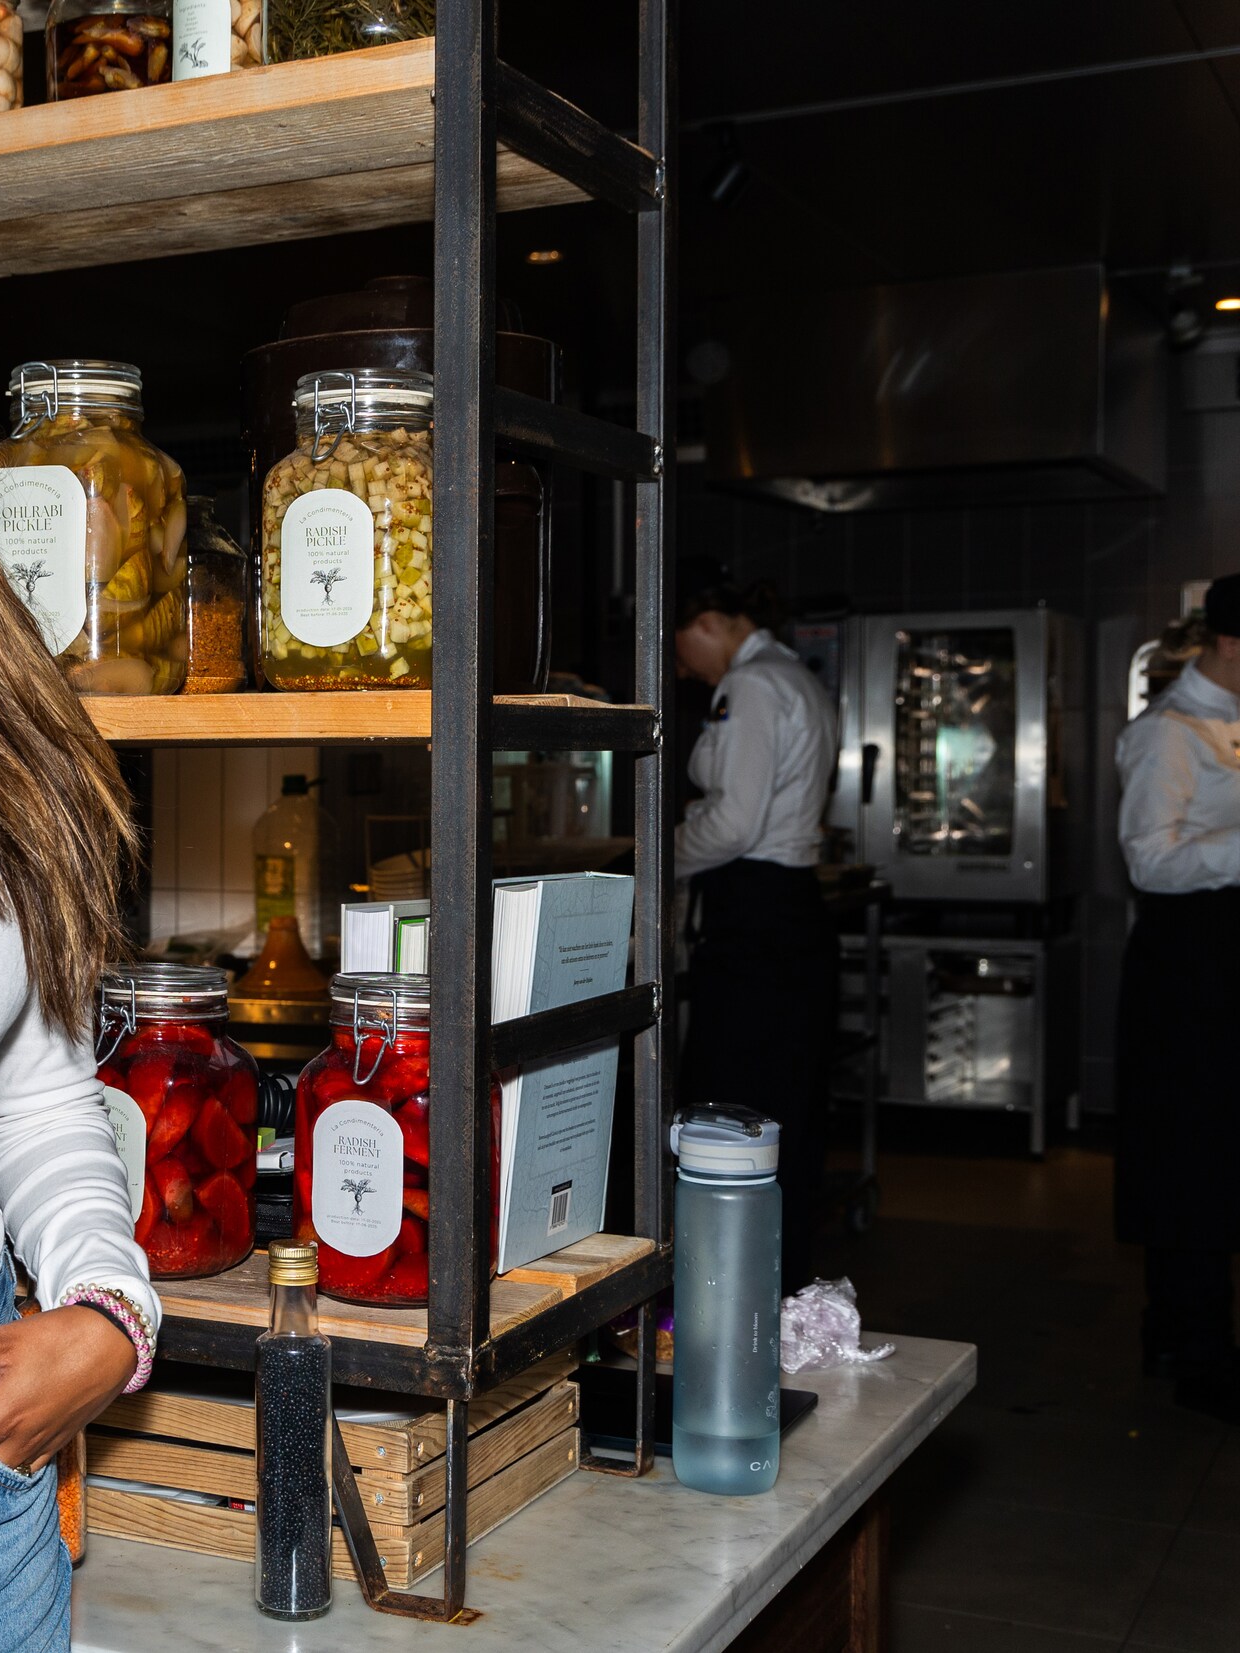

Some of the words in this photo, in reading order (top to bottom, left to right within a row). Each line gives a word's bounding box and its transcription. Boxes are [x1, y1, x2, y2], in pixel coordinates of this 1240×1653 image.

[4, 479, 61, 500] Condimenteria
[299, 515, 307, 525] La
[307, 506, 353, 522] Condimenteria
[3, 518, 53, 533] PICKLE
[305, 526, 347, 537] RADISH
[5, 538, 25, 546] 100%
[27, 536, 56, 545] natural
[306, 535, 346, 547] PICKLE
[11, 548, 48, 557] products
[331, 1124, 339, 1132] La
[340, 1118, 384, 1137] Condimenteria
[338, 1135, 376, 1149] RADISH
[333, 1144, 381, 1158] FERMENT
[343, 1169, 373, 1177] products
